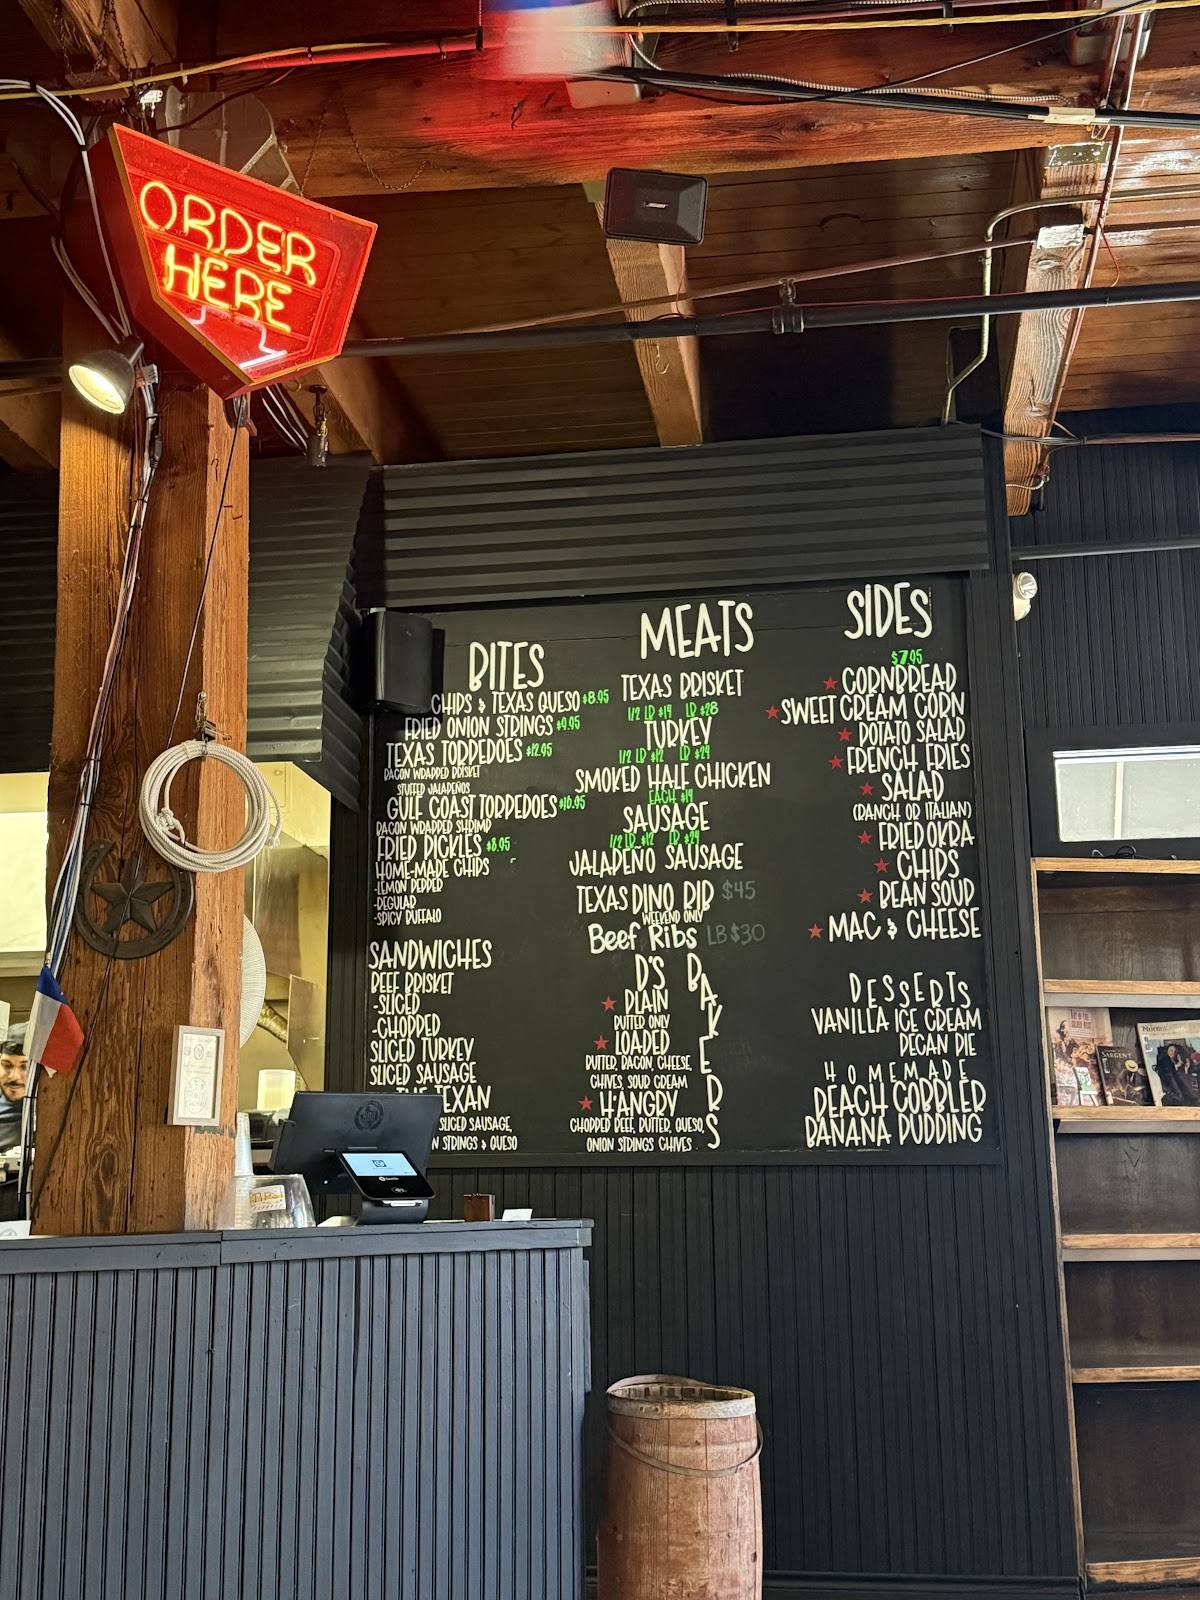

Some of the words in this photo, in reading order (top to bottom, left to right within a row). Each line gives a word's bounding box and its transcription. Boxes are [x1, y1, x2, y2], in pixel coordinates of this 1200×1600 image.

[140, 181, 316, 287] ORDER
[162, 243, 292, 333] HERE
[844, 582, 932, 639] SIDES
[641, 600, 754, 660] MEATS
[469, 641, 545, 692] BITES
[842, 662, 957, 695] CORNBREAD
[621, 673, 673, 701] TEXAS
[680, 669, 744, 699] BRISKET
[431, 693, 472, 715] CHIPS
[492, 692, 534, 714] TEXAS
[538, 690, 580, 713] QUESO
[699, 701, 719, 717] $28
[780, 695, 837, 725] SWEET
[840, 693, 907, 721] CREAM
[914, 692, 965, 719] CORN
[404, 717, 441, 741] FRIED
[447, 716, 490, 739] ONION
[496, 715, 554, 739] STRINGS
[643, 716, 713, 751] TURKEY
[859, 721, 911, 747] POTATO
[916, 717, 966, 743] SALAD
[386, 741, 434, 768] TEXAS
[441, 738, 523, 766] TORPEDOES
[846, 744, 919, 775] FRENCH
[925, 743, 970, 771] FRIES
[384, 768, 410, 781] BACON
[413, 767, 449, 780] WRAPPED
[451, 765, 481, 779] BRISKET
[574, 765, 641, 794] SMOKED
[647, 763, 690, 791] HALF
[694, 761, 771, 790] CHICKEN
[882, 770, 945, 802] SALAD
[397, 783, 425, 796] STUFFED
[648, 789, 676, 805] EACH
[387, 795, 423, 820] GULF
[429, 794, 476, 820] COAST
[479, 794, 558, 819] TORPEDOES
[622, 801, 711, 834] SAUSAGE
[853, 803, 901, 821] (RANCH
[905, 803, 920, 821] OR
[925, 801, 972, 820] ITALIAN)
[376, 821, 407, 836] BACON
[410, 820, 453, 835] WRAPPED
[456, 818, 492, 834] SHRIMP
[878, 821, 925, 851] FRIED
[927, 820, 975, 848] OKRA
[377, 835, 417, 861] FRIED
[424, 833, 482, 860] PICKLES
[569, 845, 656, 878] JALAPEÑO
[664, 842, 744, 871] SAUSAGE
[375, 859, 449, 880] HOME-MADE
[453, 857, 490, 878] CHIPS
[896, 848, 960, 881] CHIPS
[411, 878, 443, 893] PEPPER
[576, 884, 628, 914] TEXAS
[632, 882, 674, 915] DINO
[683, 879, 715, 912] RIB
[721, 879, 756, 901] $45
[879, 880, 927, 909] BEAN
[931, 878, 975, 907] SOUP
[406, 908, 441, 925] BUFFALO
[642, 910, 681, 926] WEEKEND
[683, 909, 704, 923] ONLY
[829, 911, 881, 942] MAC
[887, 918, 898, 940] &
[906, 907, 981, 940] CHEESE
[587, 921, 641, 954] Beef
[648, 923, 698, 951] Ribs
[706, 923, 727, 946] LB
[730, 922, 765, 946] $30
[368, 938, 492, 971] SANDWICHES
[370, 971, 400, 994] BEEF
[405, 971, 455, 994] BRISKET
[634, 953, 666, 992] D'S
[624, 989, 669, 1015] PLAIN
[849, 971, 971, 1009] DESSERTS
[613, 1015, 645, 1031] BUTTER
[648, 1014, 671, 1029] ONLY
[811, 1006, 889, 1035] VANILLA
[895, 1008, 919, 1033] ICE
[924, 1007, 982, 1032] CREAM
[370, 1039, 415, 1063] SLICED
[421, 1037, 475, 1062] TURKEY
[615, 1029, 671, 1056] LOADED
[900, 1033, 949, 1057] PECAN
[955, 1032, 977, 1057] PIE
[369, 1064, 411, 1086] SLICED
[416, 1061, 477, 1085] SAUSAGE
[627, 1074, 650, 1089] SOUR
[653, 1074, 688, 1089] CREAM
[814, 1081, 889, 1122] PEACH
[893, 1077, 986, 1115] COBBLER
[439, 1116, 467, 1131] SLICED
[570, 1118, 610, 1133] CHOPPED
[805, 1115, 892, 1148] BANANA
[898, 1113, 983, 1145] PUDDING
[442, 1136, 478, 1151] STRINGS
[490, 1136, 518, 1150] QUESO
[586, 1137, 614, 1152] ONION
[617, 1137, 654, 1152] STRINGS
[658, 1136, 692, 1152] CHIVES
